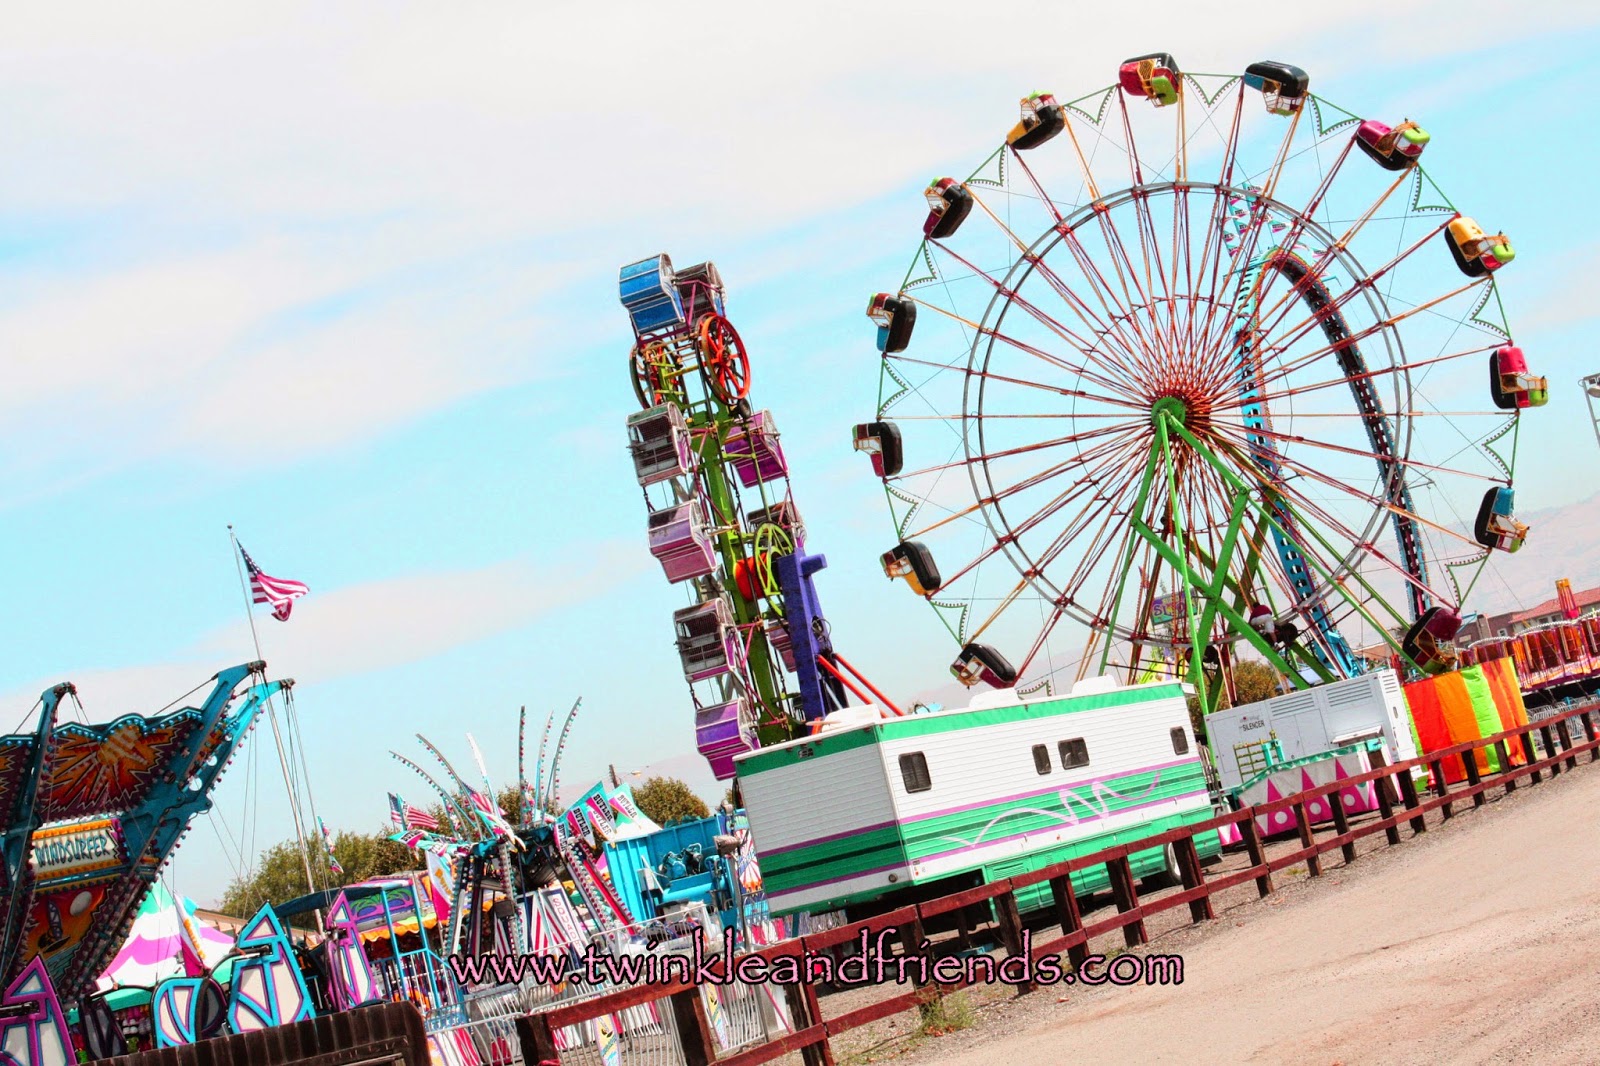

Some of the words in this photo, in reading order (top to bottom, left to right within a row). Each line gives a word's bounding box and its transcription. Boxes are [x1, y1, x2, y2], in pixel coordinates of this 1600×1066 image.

[593, 793, 614, 822] BUTLER
[617, 794, 638, 818] BUTLER
[573, 807, 591, 837] BUTLER
[34, 835, 111, 868] WINDSURFER
